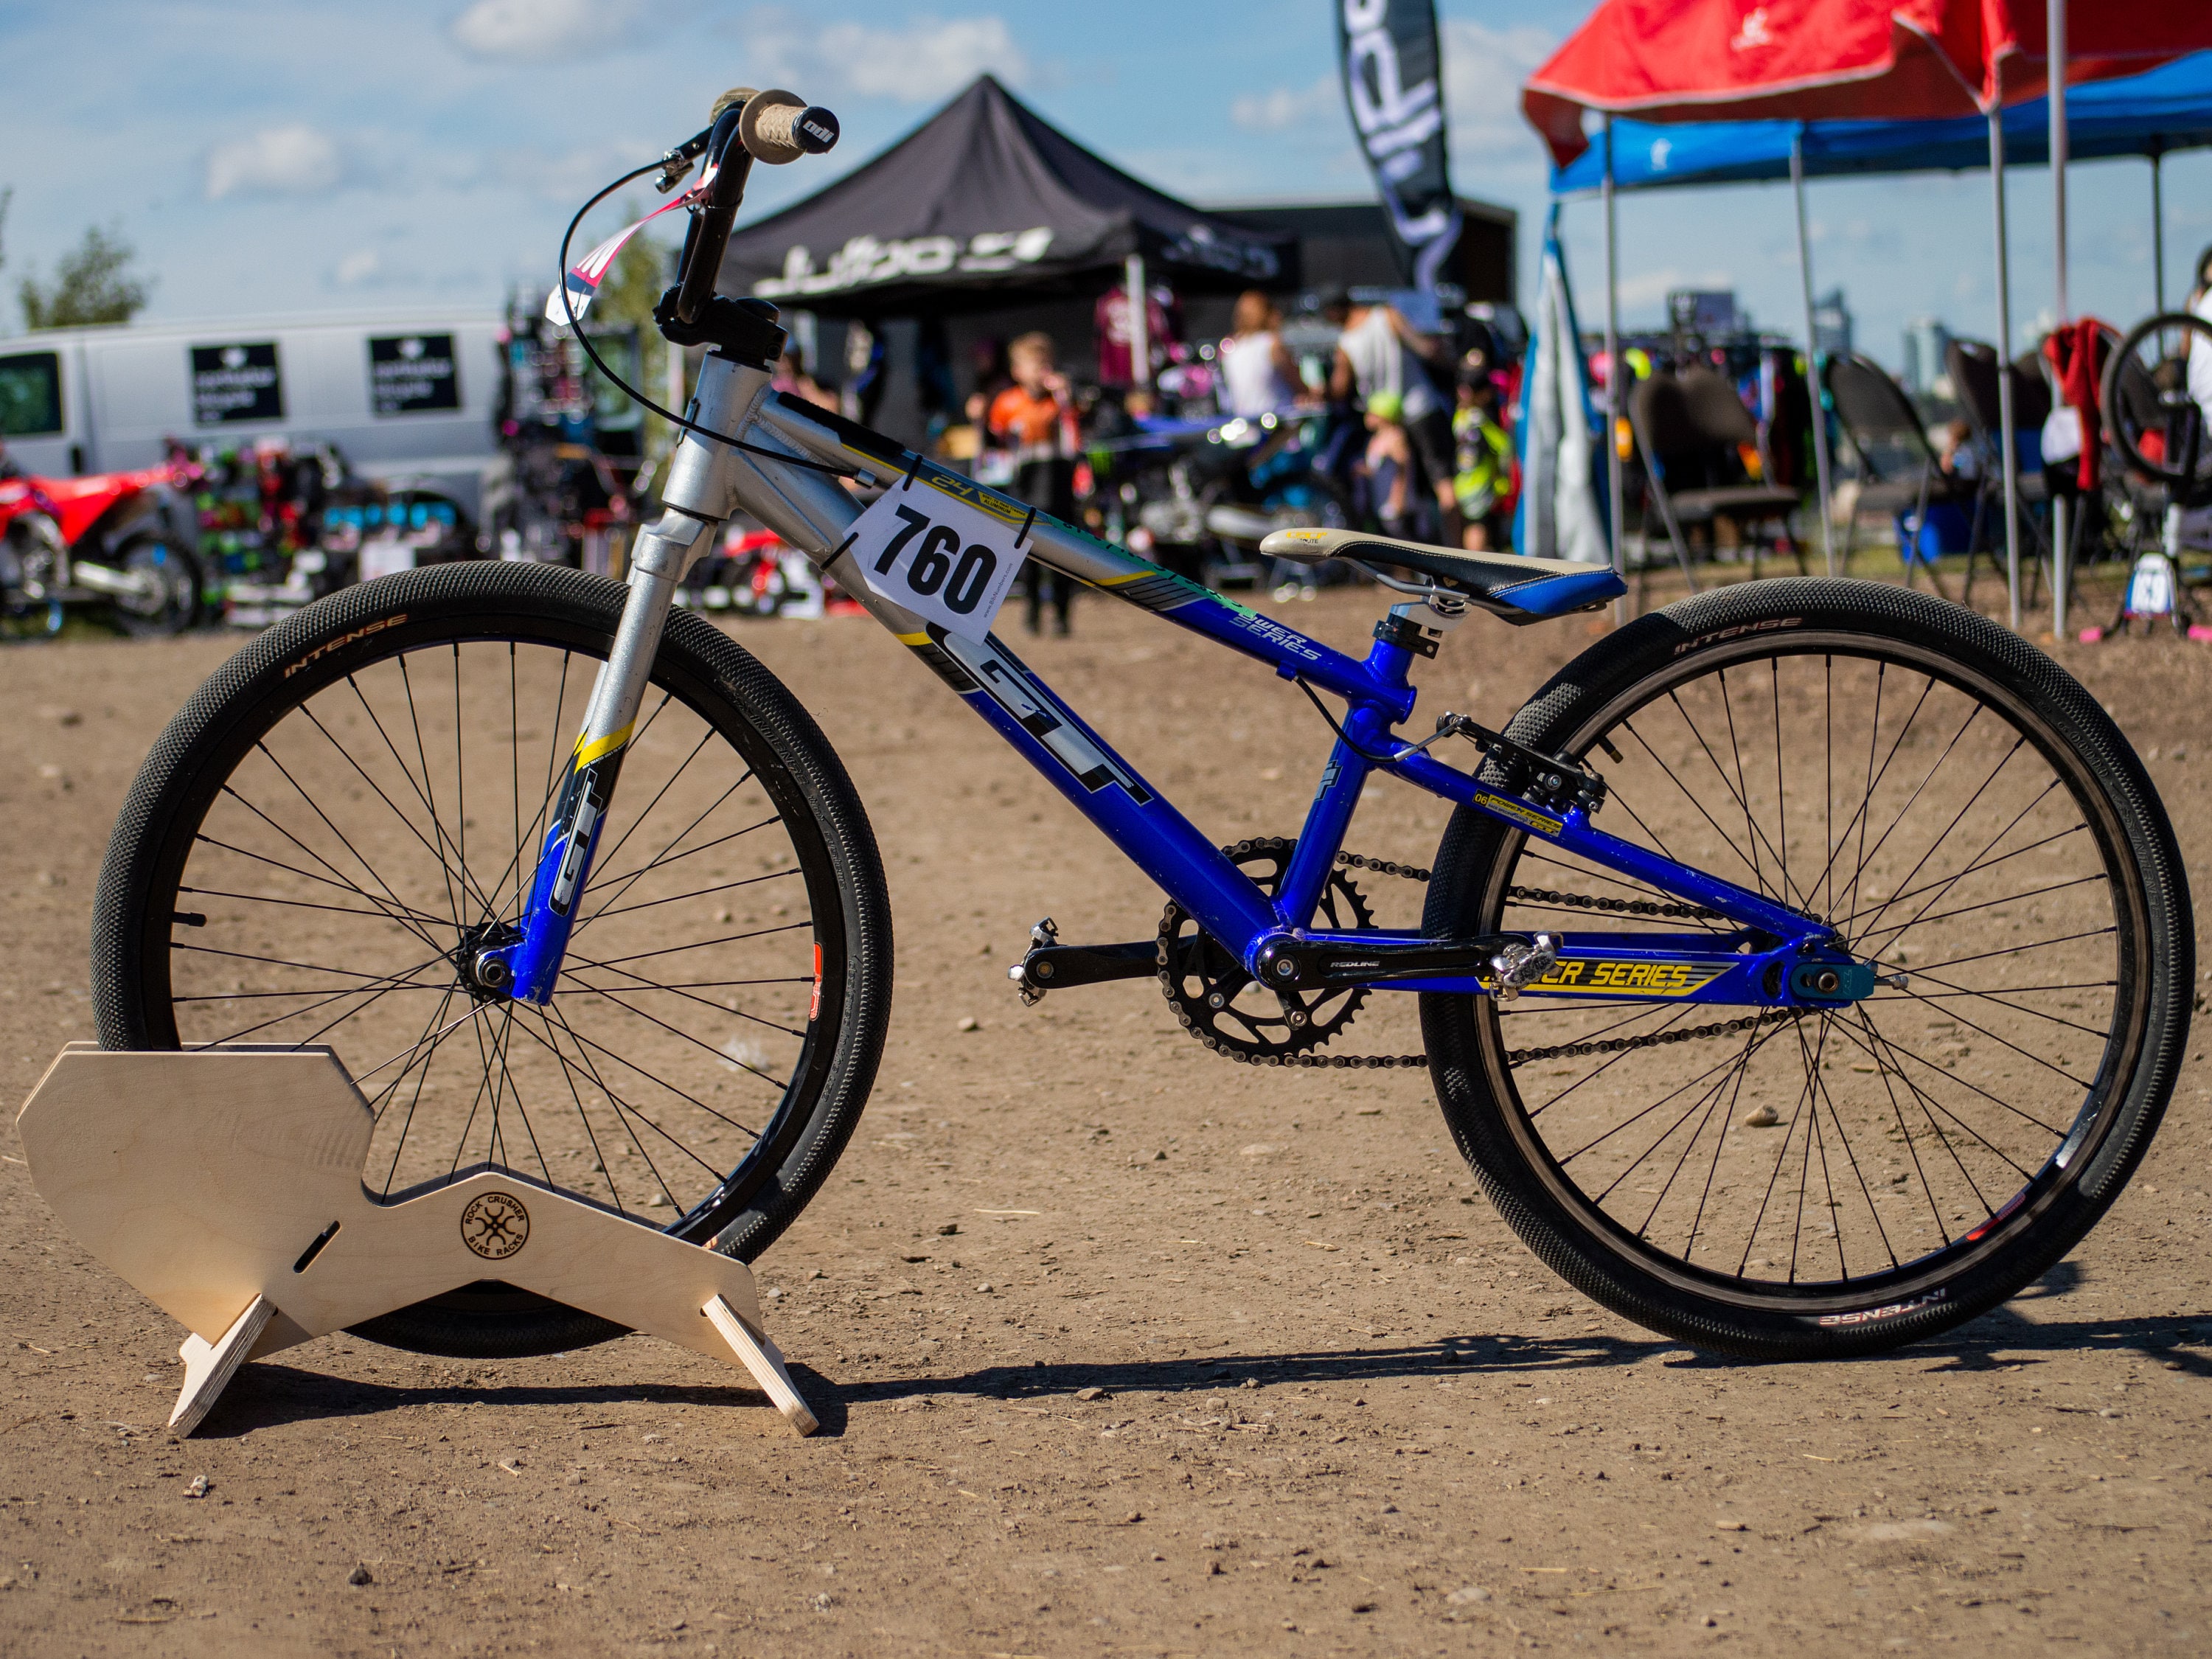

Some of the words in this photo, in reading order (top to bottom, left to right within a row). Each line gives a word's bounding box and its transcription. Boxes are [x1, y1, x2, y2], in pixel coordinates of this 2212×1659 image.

[803, 120, 834, 143] odi
[932, 474, 973, 496] 24
[984, 499, 1011, 514] ALUMINUM
[874, 503, 997, 615] 760
[284, 613, 408, 679] INTENSE
[1228, 616, 1322, 661] SERIES
[1674, 617, 1803, 655] INTENSE
[1475, 793, 1488, 804] 06
[1525, 811, 1562, 829] SERIES
[1589, 962, 1692, 987] SERIES
[465, 1201, 484, 1225] ROCK
[487, 1195, 525, 1222] CRUSHER
[467, 1235, 491, 1256] BIKE
[496, 1234, 524, 1256] RACKS
[1818, 1287, 1947, 1326] INTENSE
